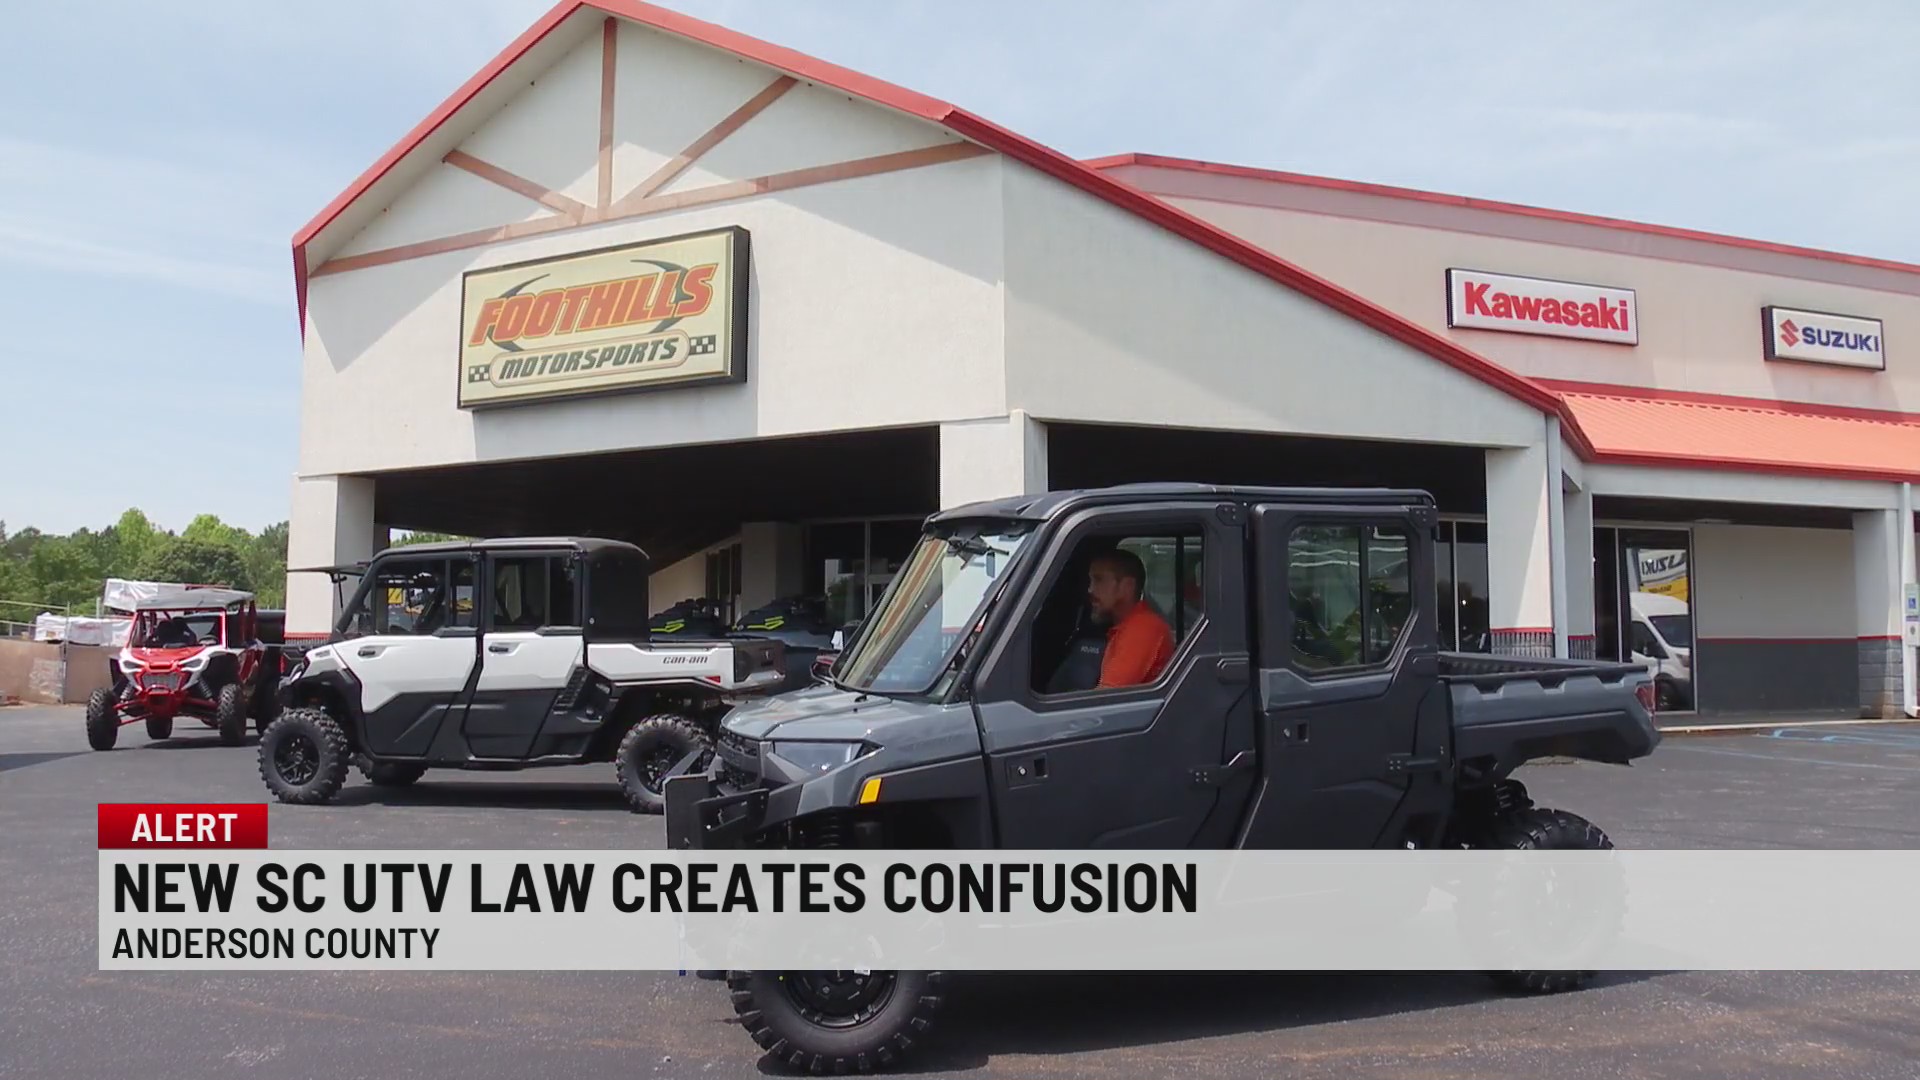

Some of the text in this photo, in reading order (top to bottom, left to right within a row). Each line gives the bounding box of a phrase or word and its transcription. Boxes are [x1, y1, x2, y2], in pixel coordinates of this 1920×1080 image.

[468, 263, 718, 347] FOOTHILLS
[1464, 281, 1629, 331] Kawasaki
[499, 336, 680, 381] MOTORSPORTS
[1801, 326, 1880, 353] SUZUKI
